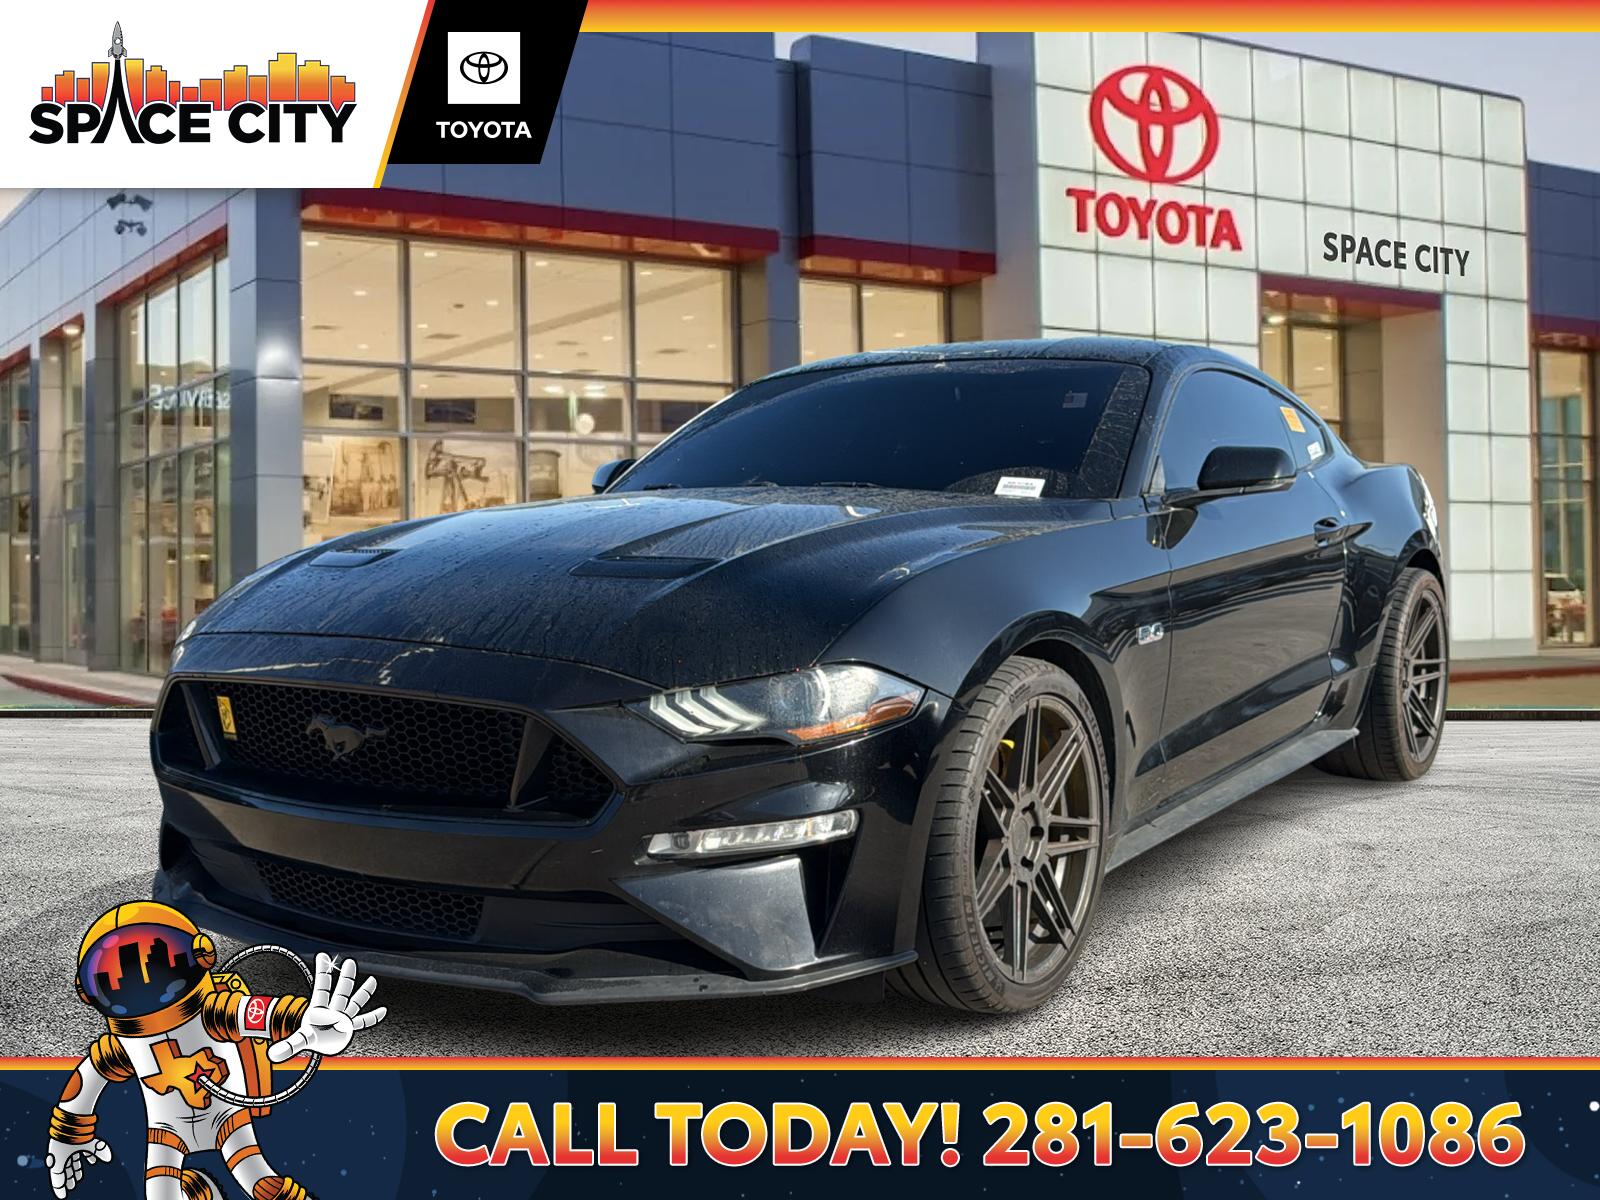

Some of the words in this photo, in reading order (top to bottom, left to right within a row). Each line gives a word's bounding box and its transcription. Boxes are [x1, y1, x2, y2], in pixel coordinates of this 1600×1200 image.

[1066, 187, 1242, 251] TOYOTA
[1323, 232, 1407, 270] SPACE
[1414, 243, 1470, 277] CITY
[964, 900, 996, 983] MICHELIN
